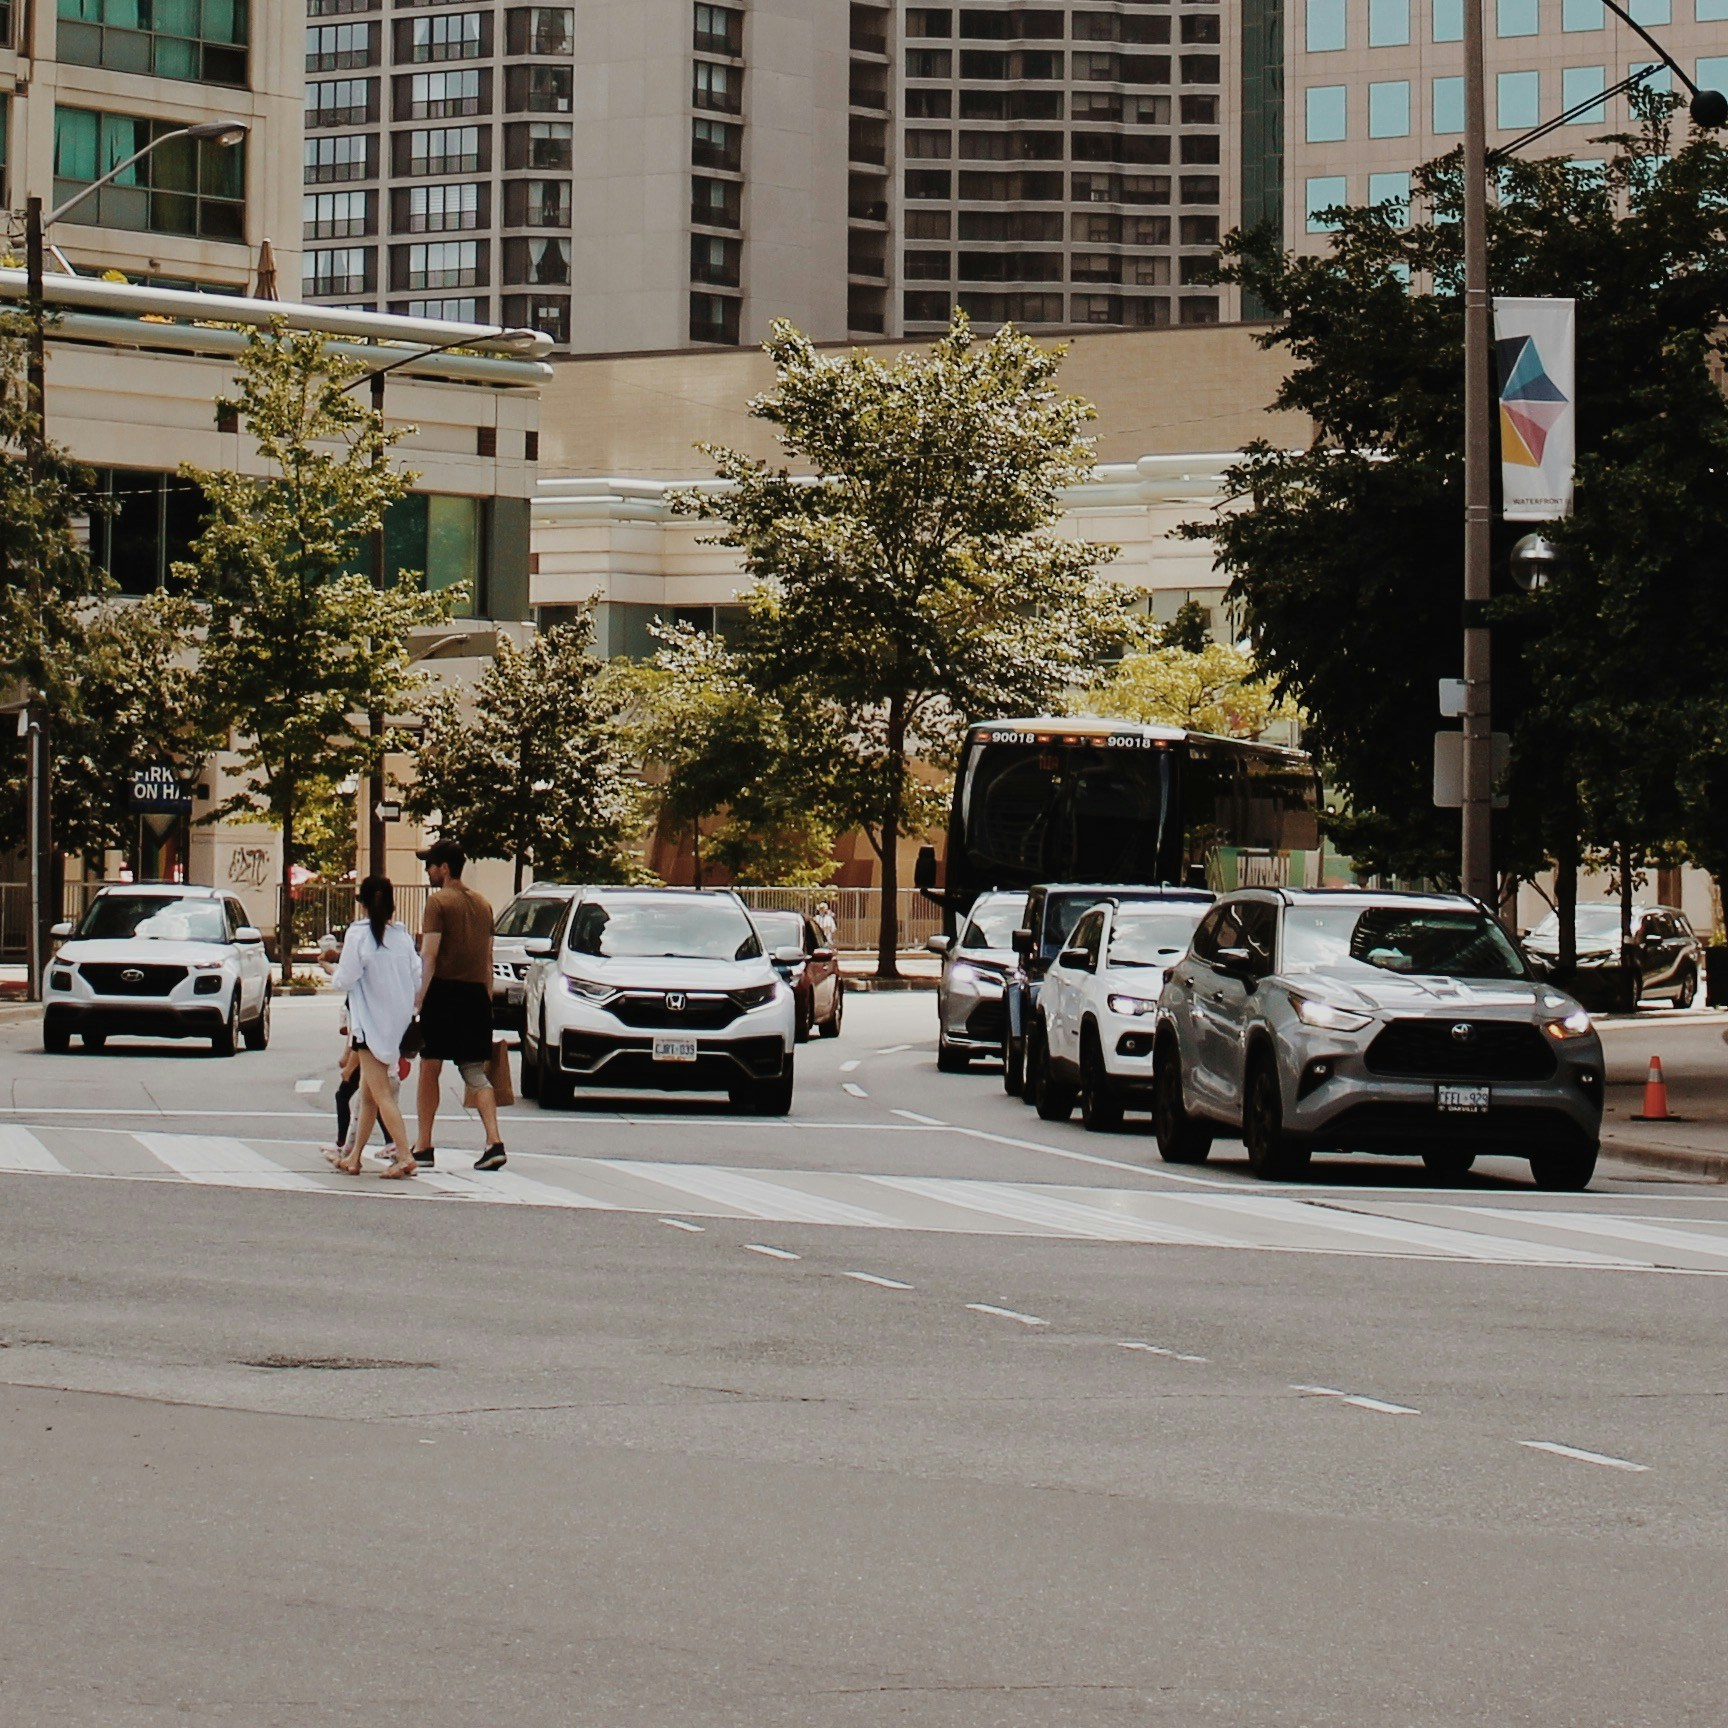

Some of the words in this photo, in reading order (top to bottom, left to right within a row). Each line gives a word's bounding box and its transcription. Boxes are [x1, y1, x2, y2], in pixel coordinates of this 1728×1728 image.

[1512, 497, 1563, 505] WATERFRONT
[991, 731, 1035, 744] 90018
[1107, 736, 1151, 749] 90018
[134, 783, 158, 800] ON
